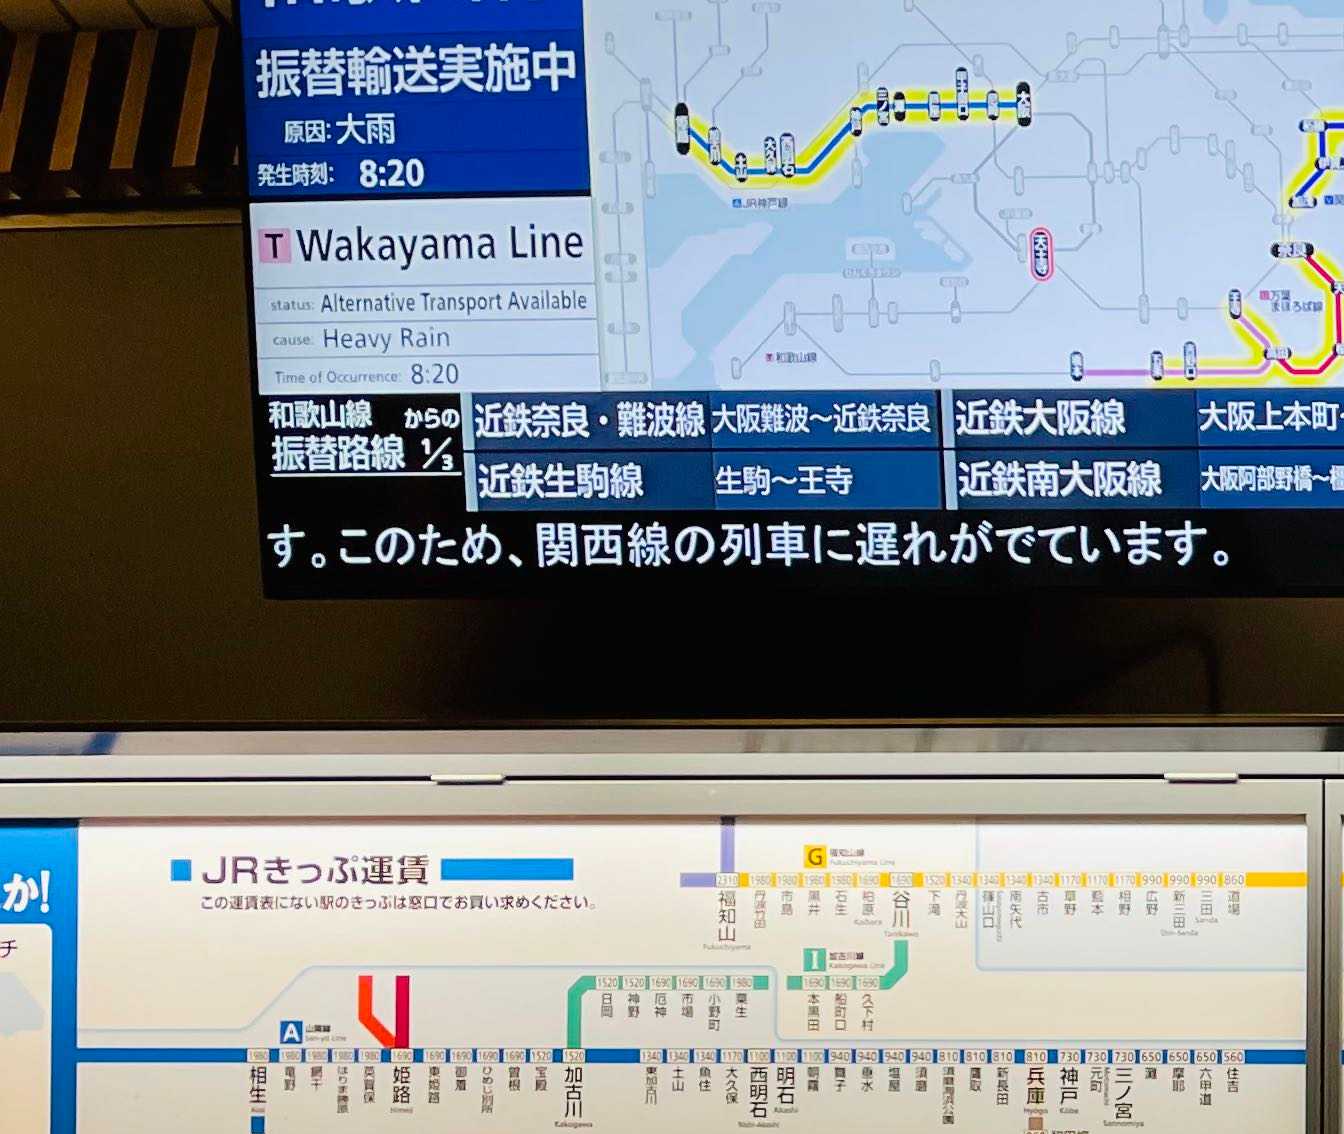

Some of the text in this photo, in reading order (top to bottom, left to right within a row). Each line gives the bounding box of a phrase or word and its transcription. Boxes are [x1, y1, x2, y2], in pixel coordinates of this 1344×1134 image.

[255, 42, 577, 99] 振替輸送実施中
[335, 113, 396, 146] 大雨
[359, 158, 424, 188] 8:20
[265, 223, 585, 270] T Wakayama Line
[270, 290, 588, 316] status: Alternative Transport Available
[272, 328, 451, 353] cause: Heavy Rain
[274, 363, 459, 386] Time of Occurrence: 8:20
[269, 400, 461, 430] 和歌山線 からの
[475, 401, 706, 440] 近鉄奈良・難波線
[956, 399, 1126, 437] 近鉄大阪線
[271, 435, 405, 472] 振替路線
[478, 463, 644, 500] 近鉄生駒線
[958, 461, 1163, 499] 近鉄南大阪線
[266, 520, 1233, 569] す。このため、関西線の列車に遅れがでています。
[201, 854, 430, 887] JRきっぷ運賃
[200, 894, 598, 912] この運賃表にない駅のきっぷは窓口でお買い求めください。
[718, 890, 737, 943] 福知山
[892, 890, 911, 929] 谷川
[249, 1067, 267, 1105] 相生
[393, 1067, 411, 1105] 姫路
[564, 1067, 583, 1118] 加古川
[750, 1068, 769, 1119] 西明石
[776, 1068, 795, 1106] 明石
[1027, 1068, 1045, 1106] 兵庫
[1060, 1068, 1079, 1106] 神戸
